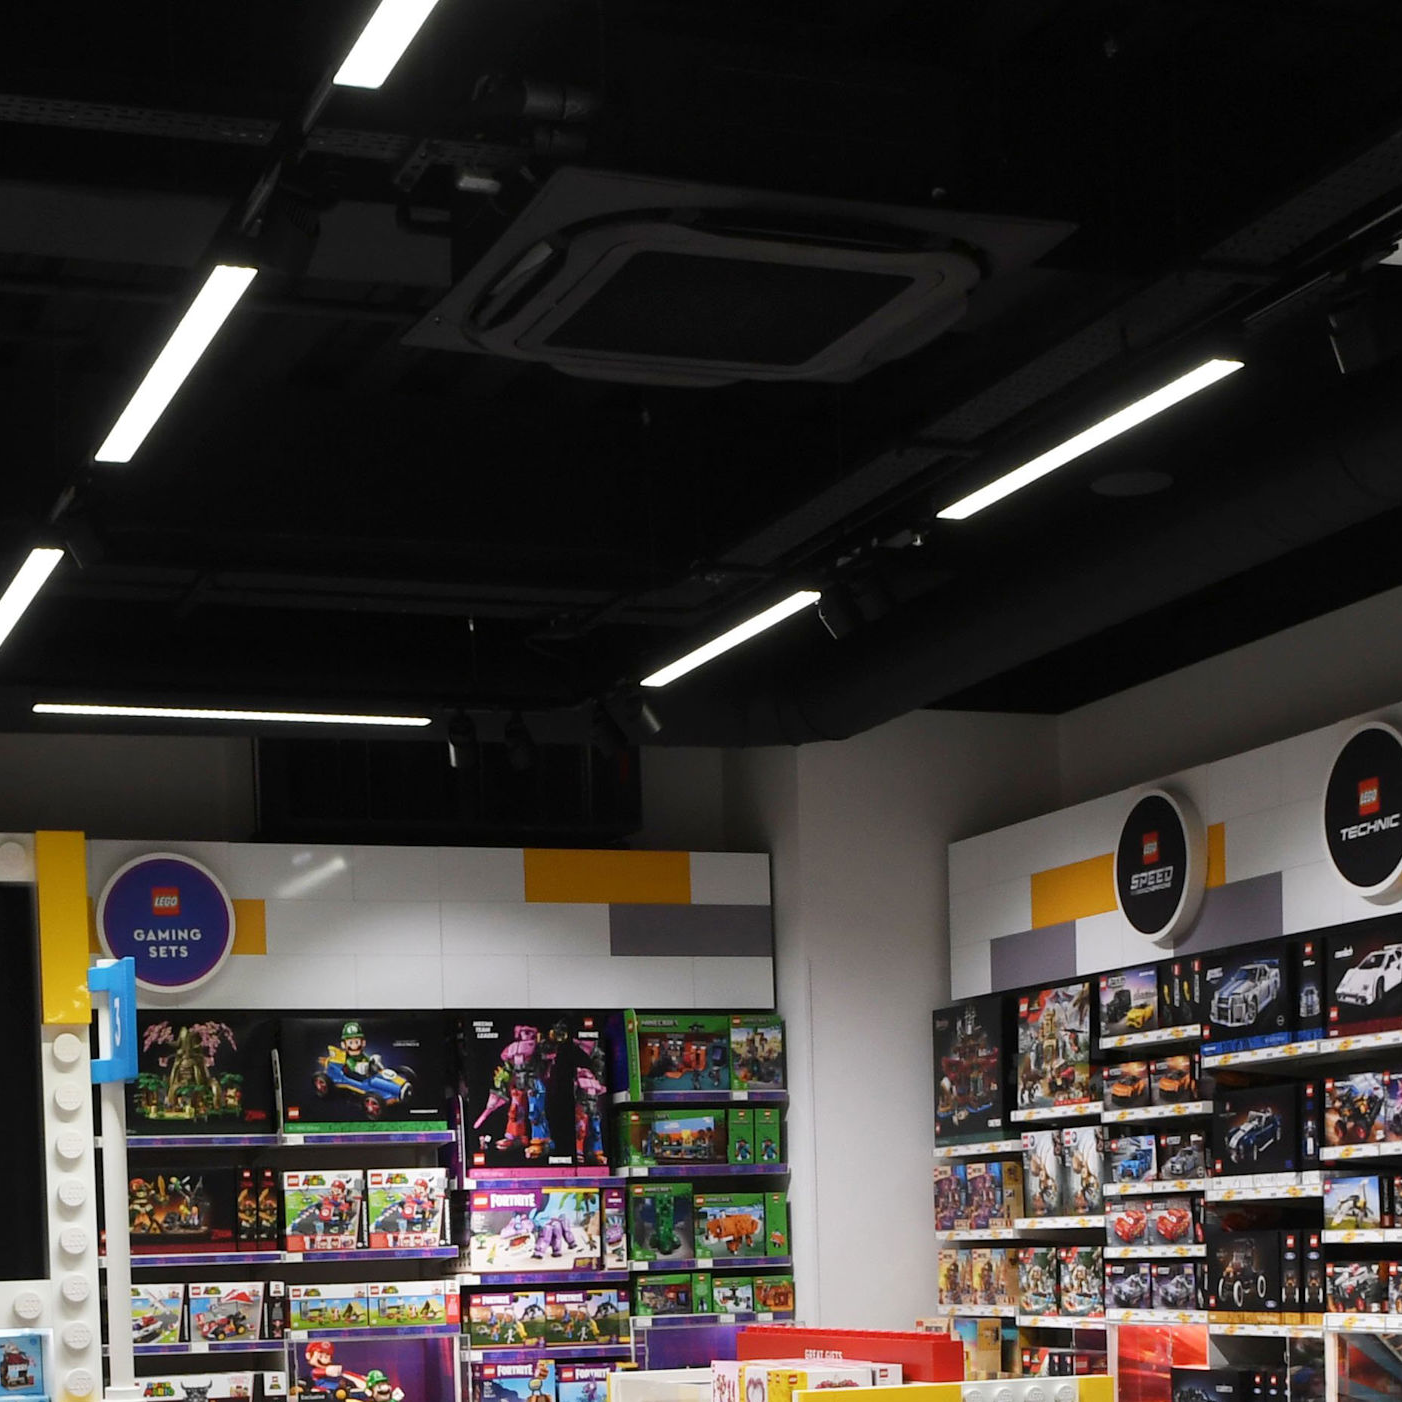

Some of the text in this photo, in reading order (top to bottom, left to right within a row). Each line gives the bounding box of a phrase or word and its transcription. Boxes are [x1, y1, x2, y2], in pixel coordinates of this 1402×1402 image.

[1359, 788, 1378, 806] LEGO
[1340, 813, 1400, 842] TECHNIC
[1130, 865, 1173, 890] SPEED
[154, 896, 177, 907] LEGO
[133, 929, 202, 941] GAMING
[149, 946, 189, 958] SETS
[490, 1193, 535, 1209] FORTNITE
[497, 1364, 533, 1377] FORTNITE
